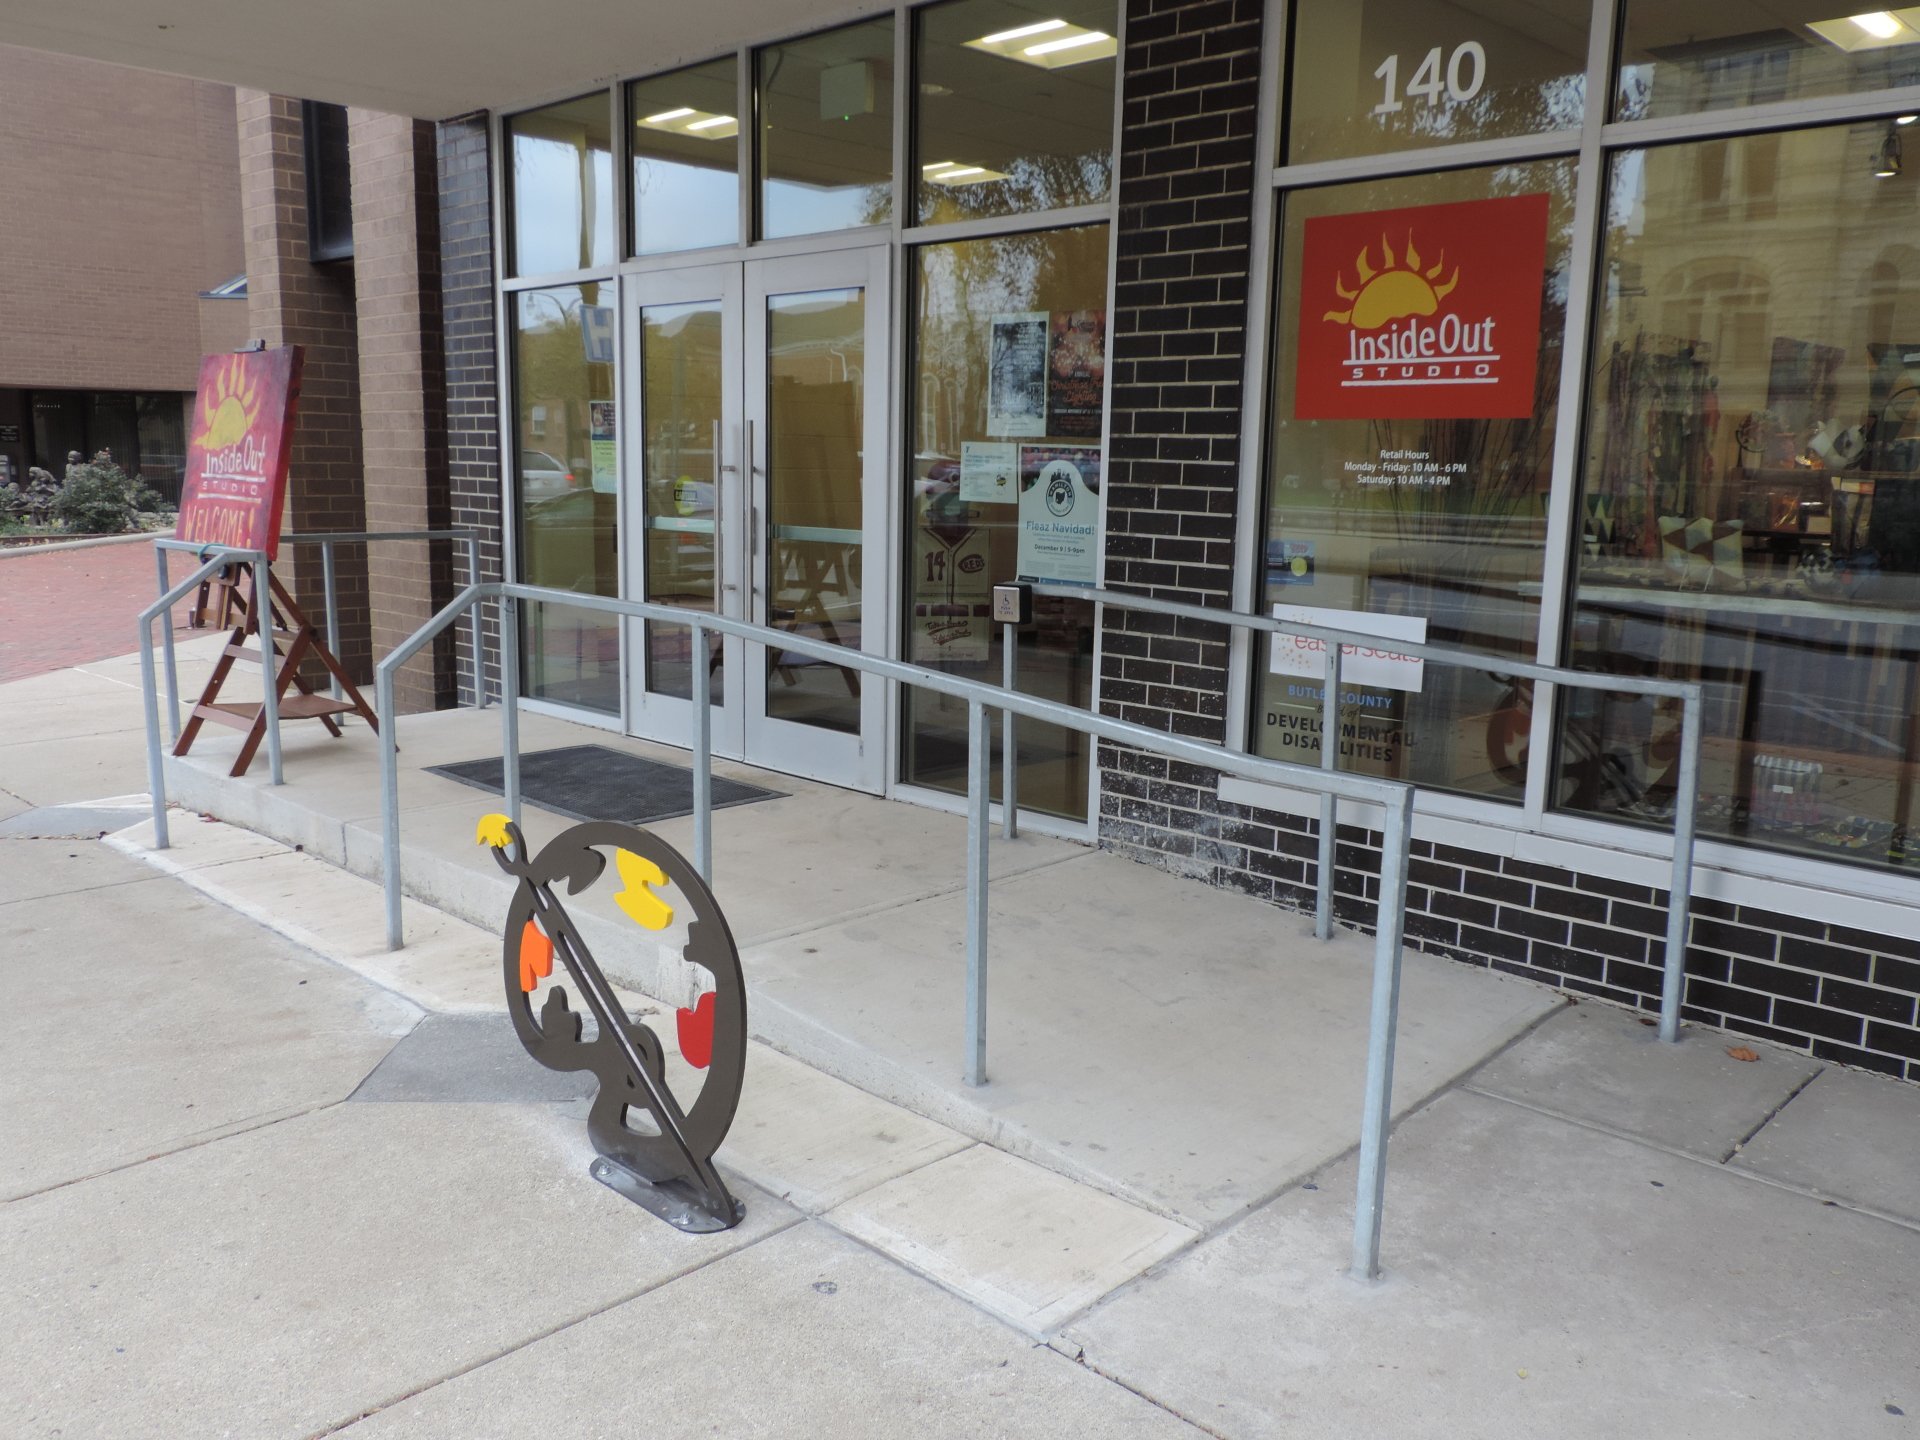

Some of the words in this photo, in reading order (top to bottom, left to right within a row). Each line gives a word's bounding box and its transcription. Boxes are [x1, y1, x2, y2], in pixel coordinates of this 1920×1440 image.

[1374, 41, 1486, 114] 140
[1352, 363, 1490, 379] STUDIO
[1380, 449, 1403, 459] Retail
[1405, 450, 1430, 460] Hours
[1344, 461, 1377, 473] Monday
[1382, 462, 1411, 474] Friday:
[1412, 463, 1422, 472] 10
[1424, 463, 1439, 473] AM
[1445, 463, 1451, 472] 6
[1452, 463, 1467, 473] PM
[1357, 474, 1396, 486] Saturday:
[1397, 475, 1407, 485] 10
[1408, 475, 1423, 485] AM
[1429, 475, 1435, 485] 4
[1436, 476, 1451, 486] PM
[202, 481, 258, 496] STUDIO
[1026, 520, 1050, 532] Fleaz
[1052, 522, 1095, 536] Navidad!
[1034, 543, 1059, 551] December
[925, 550, 946, 582] 14
[1287, 684, 1326, 699] BUTLE
[1339, 691, 1392, 709] COUNTY
[1267, 712, 1416, 747] DEVELMENTAL
[1282, 732, 1393, 762] DISALITIES
